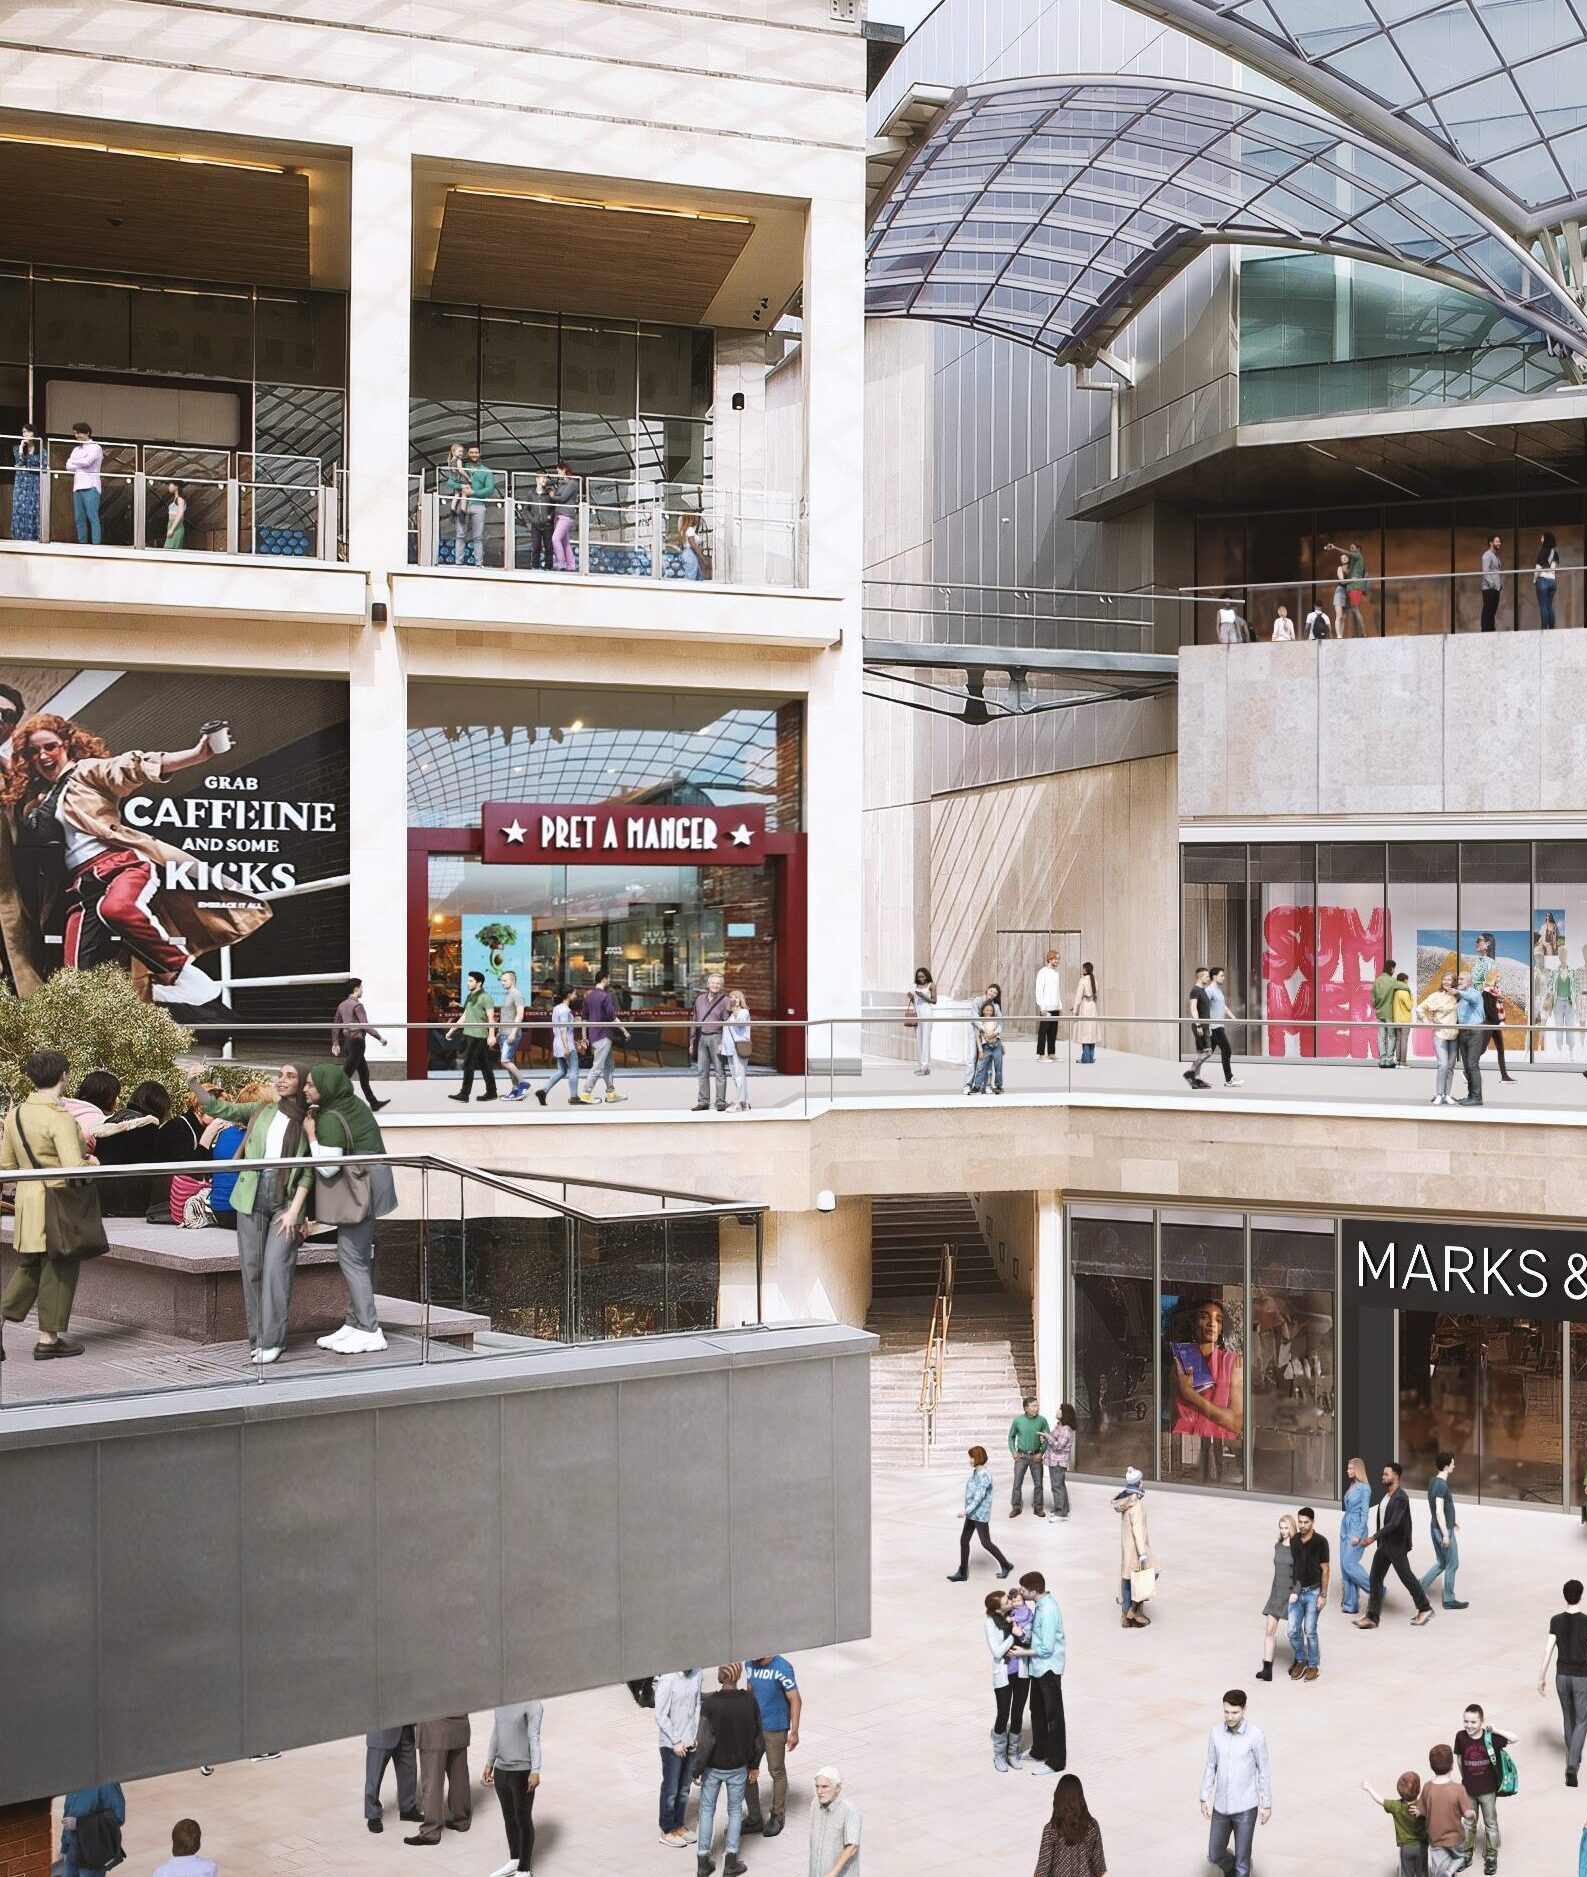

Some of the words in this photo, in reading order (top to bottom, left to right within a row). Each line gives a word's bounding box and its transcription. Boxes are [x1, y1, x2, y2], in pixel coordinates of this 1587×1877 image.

[204, 775, 259, 791] GRAB
[123, 796, 337, 832] CAFFEINE
[182, 837, 224, 851] AND
[226, 838, 280, 853] SOME
[540, 815, 597, 849] PRET
[603, 816, 618, 849] A
[626, 816, 718, 850] MANGER
[165, 860, 296, 893] KICKS
[1263, 904, 1392, 980] SUM
[1356, 1240, 1549, 1299] MARKS
[753, 1668, 773, 1680] VIDI
